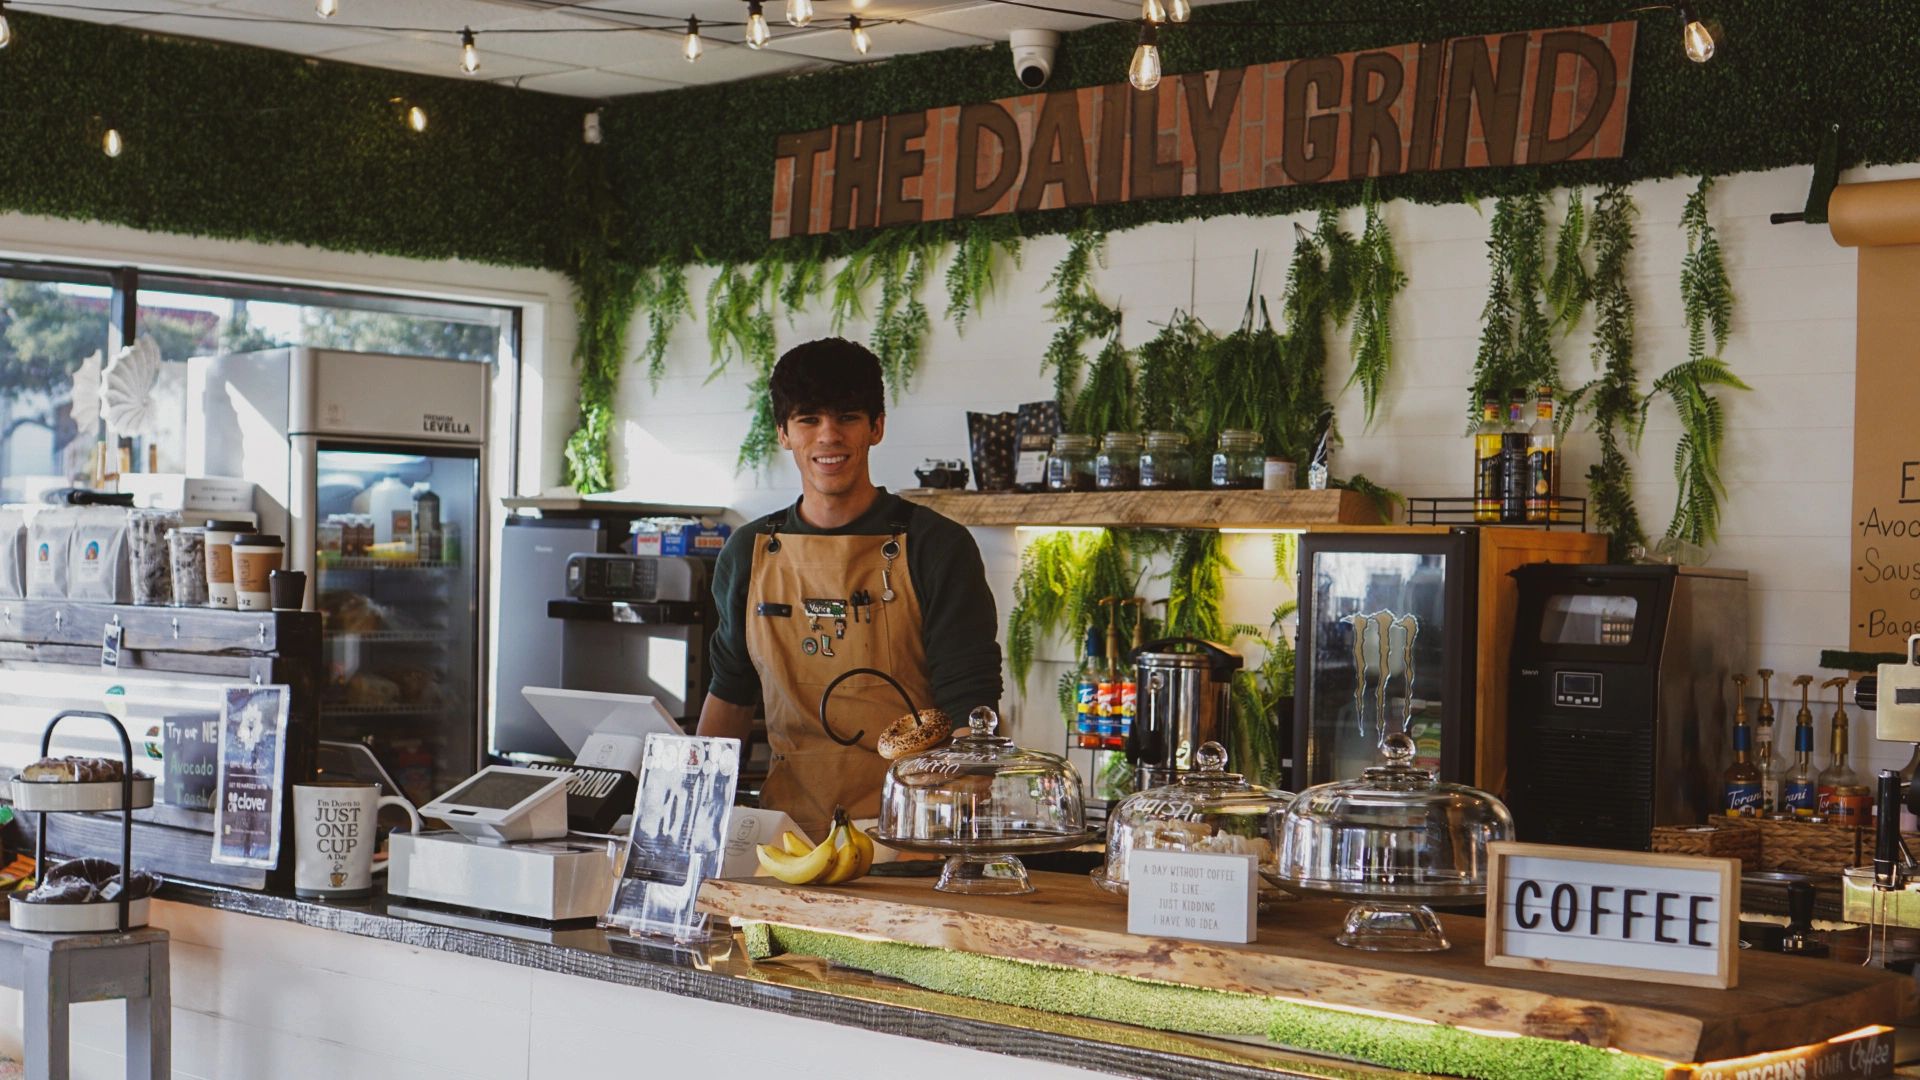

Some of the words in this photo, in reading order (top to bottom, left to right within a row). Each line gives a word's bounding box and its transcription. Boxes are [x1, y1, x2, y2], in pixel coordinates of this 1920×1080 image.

[776, 111, 927, 234] THE
[953, 66, 1250, 216] DAILY
[1282, 31, 1617, 183] GRIND
[423, 420, 471, 434] LEVELLA
[165, 722, 181, 744] Try
[202, 721, 220, 744] NE
[169, 753, 214, 776] Avocado
[237, 792, 267, 811] clover
[318, 799, 330, 807] I'm
[331, 800, 352, 808] Down
[315, 807, 361, 823] JUST
[316, 823, 359, 838] ONE
[317, 838, 358, 854] CUP
[1143, 864, 1149, 875] A
[1151, 865, 1168, 876] DAY
[1170, 866, 1204, 879] WITHOUT
[1206, 869, 1236, 881] COFFEE
[1169, 881, 1179, 894] IS
[1182, 884, 1201, 896] LIKE
[1158, 898, 1178, 910] JUST
[1182, 901, 1216, 913] KIDDING
[1515, 880, 1714, 947] COFFEE
[1160, 915, 1181, 928] HAVE
[1185, 917, 1197, 929] NO
[1849, 1037, 1890, 1077] Coffee
